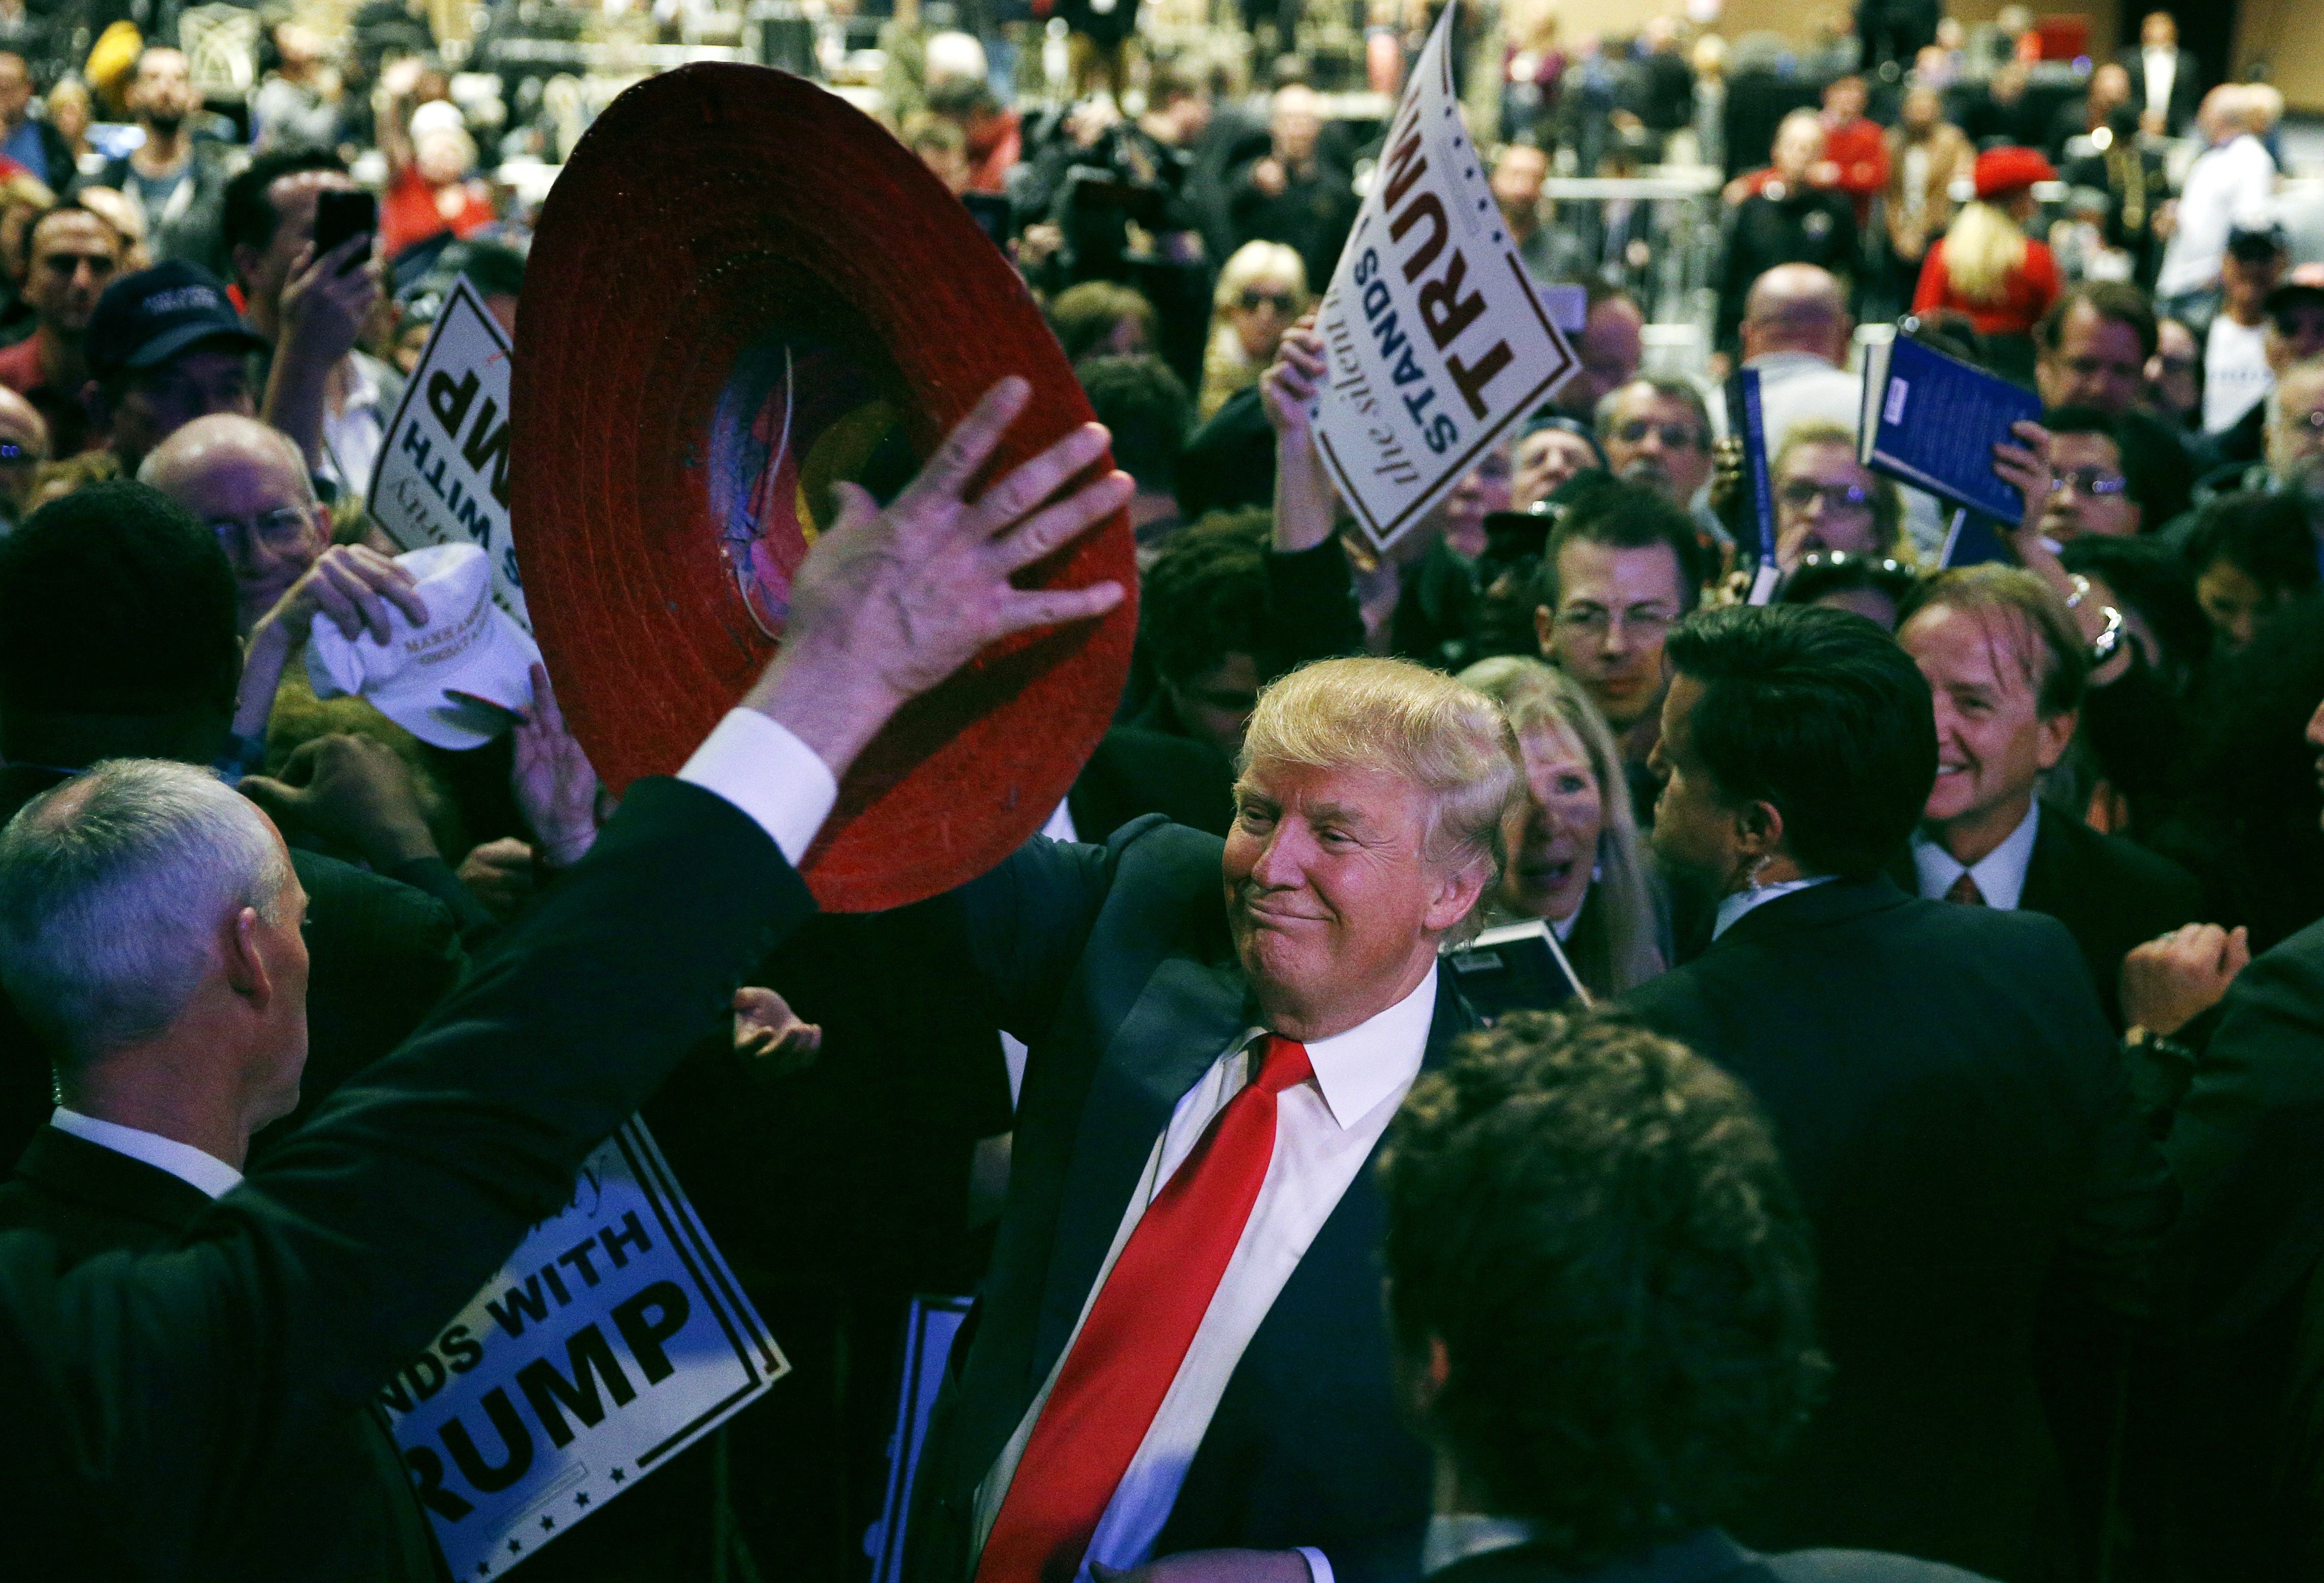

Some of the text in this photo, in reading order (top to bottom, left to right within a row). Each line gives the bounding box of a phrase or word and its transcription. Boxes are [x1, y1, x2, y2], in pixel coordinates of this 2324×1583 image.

[1385, 85, 1515, 421] TRUM
[1354, 248, 1458, 455] STANDS
[403, 419, 491, 550] WITH
[1370, 422, 1420, 485] the
[485, 1211, 653, 1339] WITH
